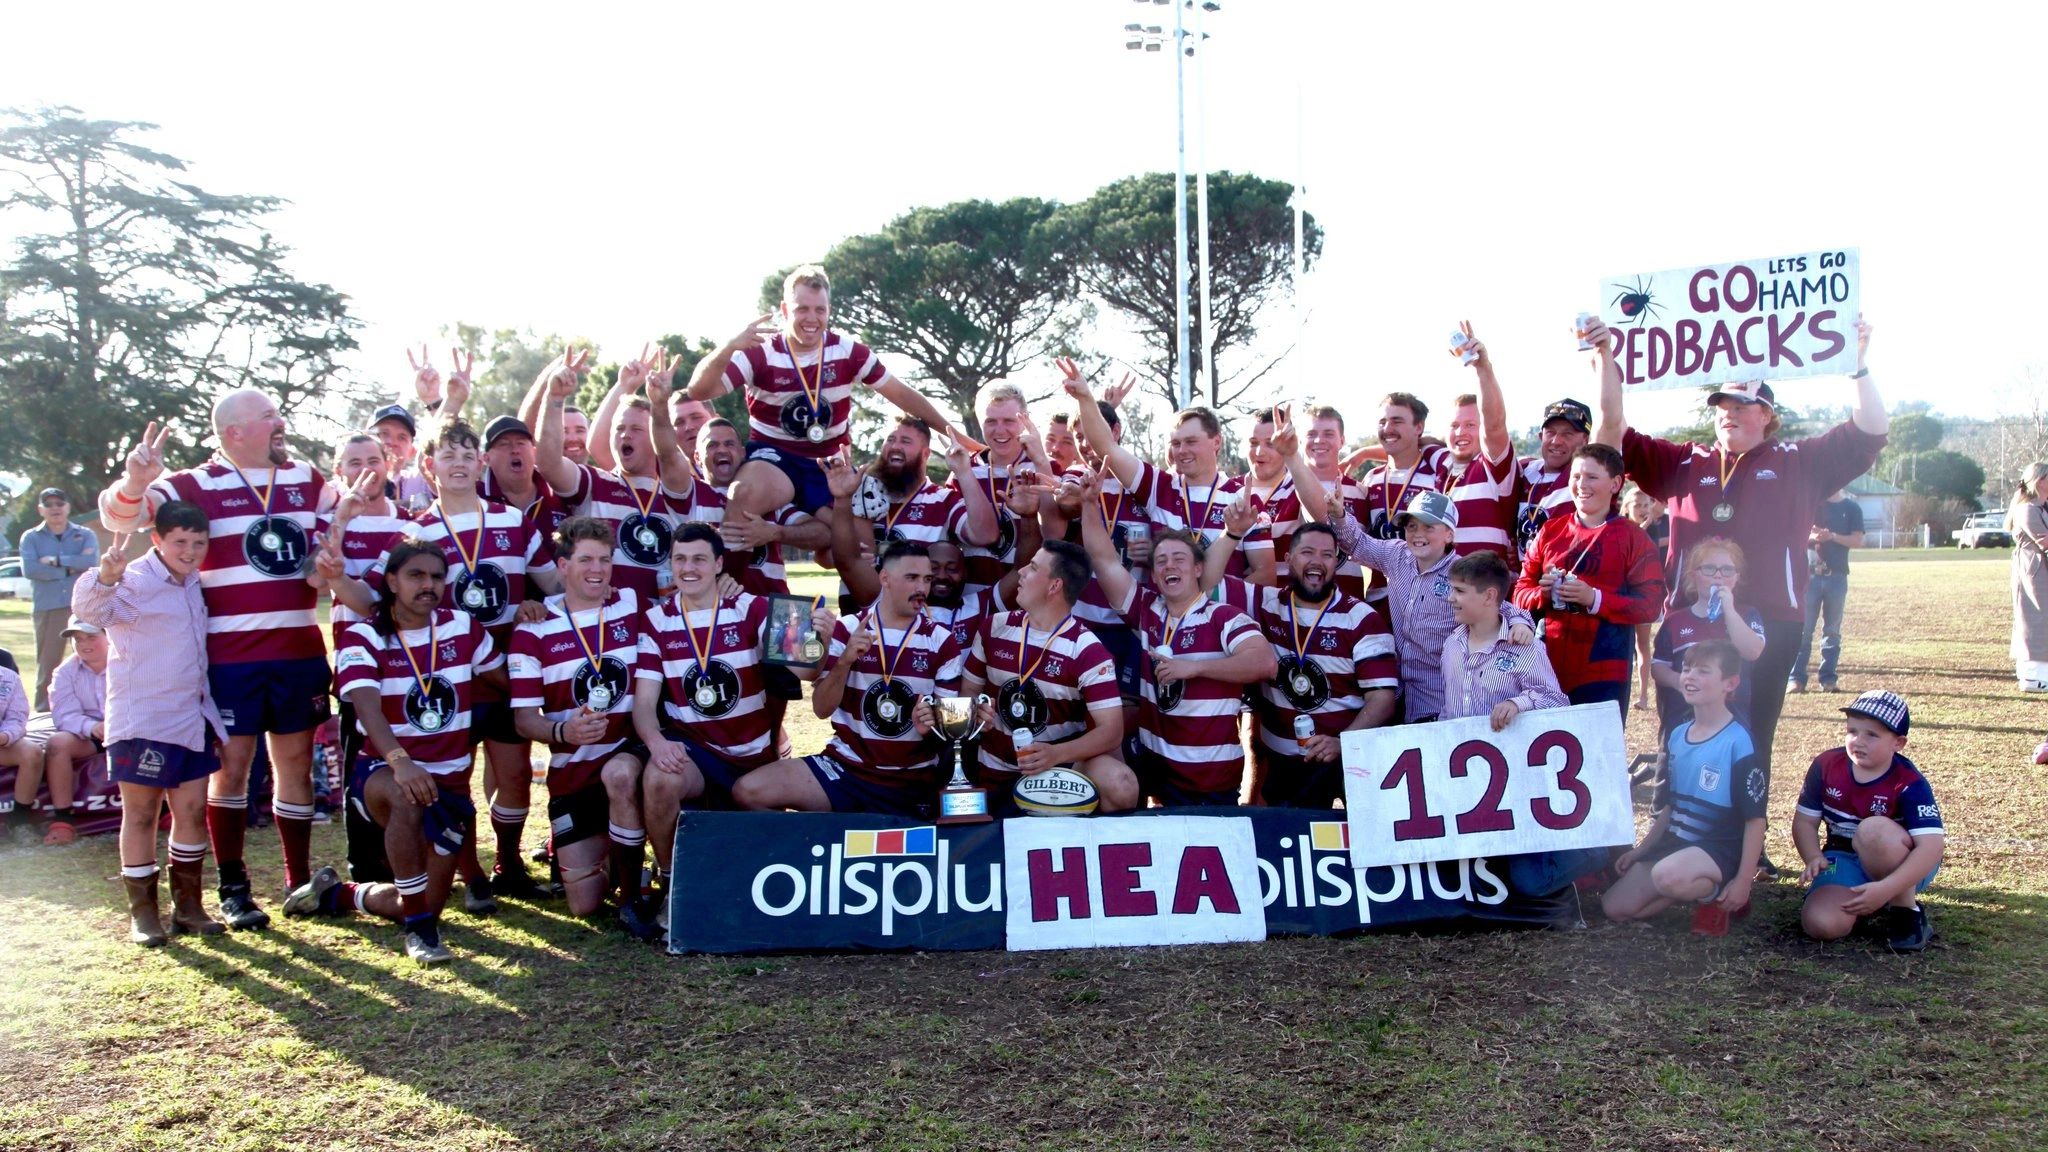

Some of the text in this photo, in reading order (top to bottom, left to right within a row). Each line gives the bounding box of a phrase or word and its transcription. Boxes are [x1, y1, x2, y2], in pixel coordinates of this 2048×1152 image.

[1768, 251, 1846, 274] LETS GO
[1689, 265, 1758, 313] GO
[1758, 272, 1849, 311] HAMO
[1024, 779, 1088, 794] GILBERT
[1379, 729, 1592, 842] 123
[1917, 804, 1939, 818] R&S
[751, 838, 1003, 936] oilsplu
[1028, 842, 1242, 923] HEA
